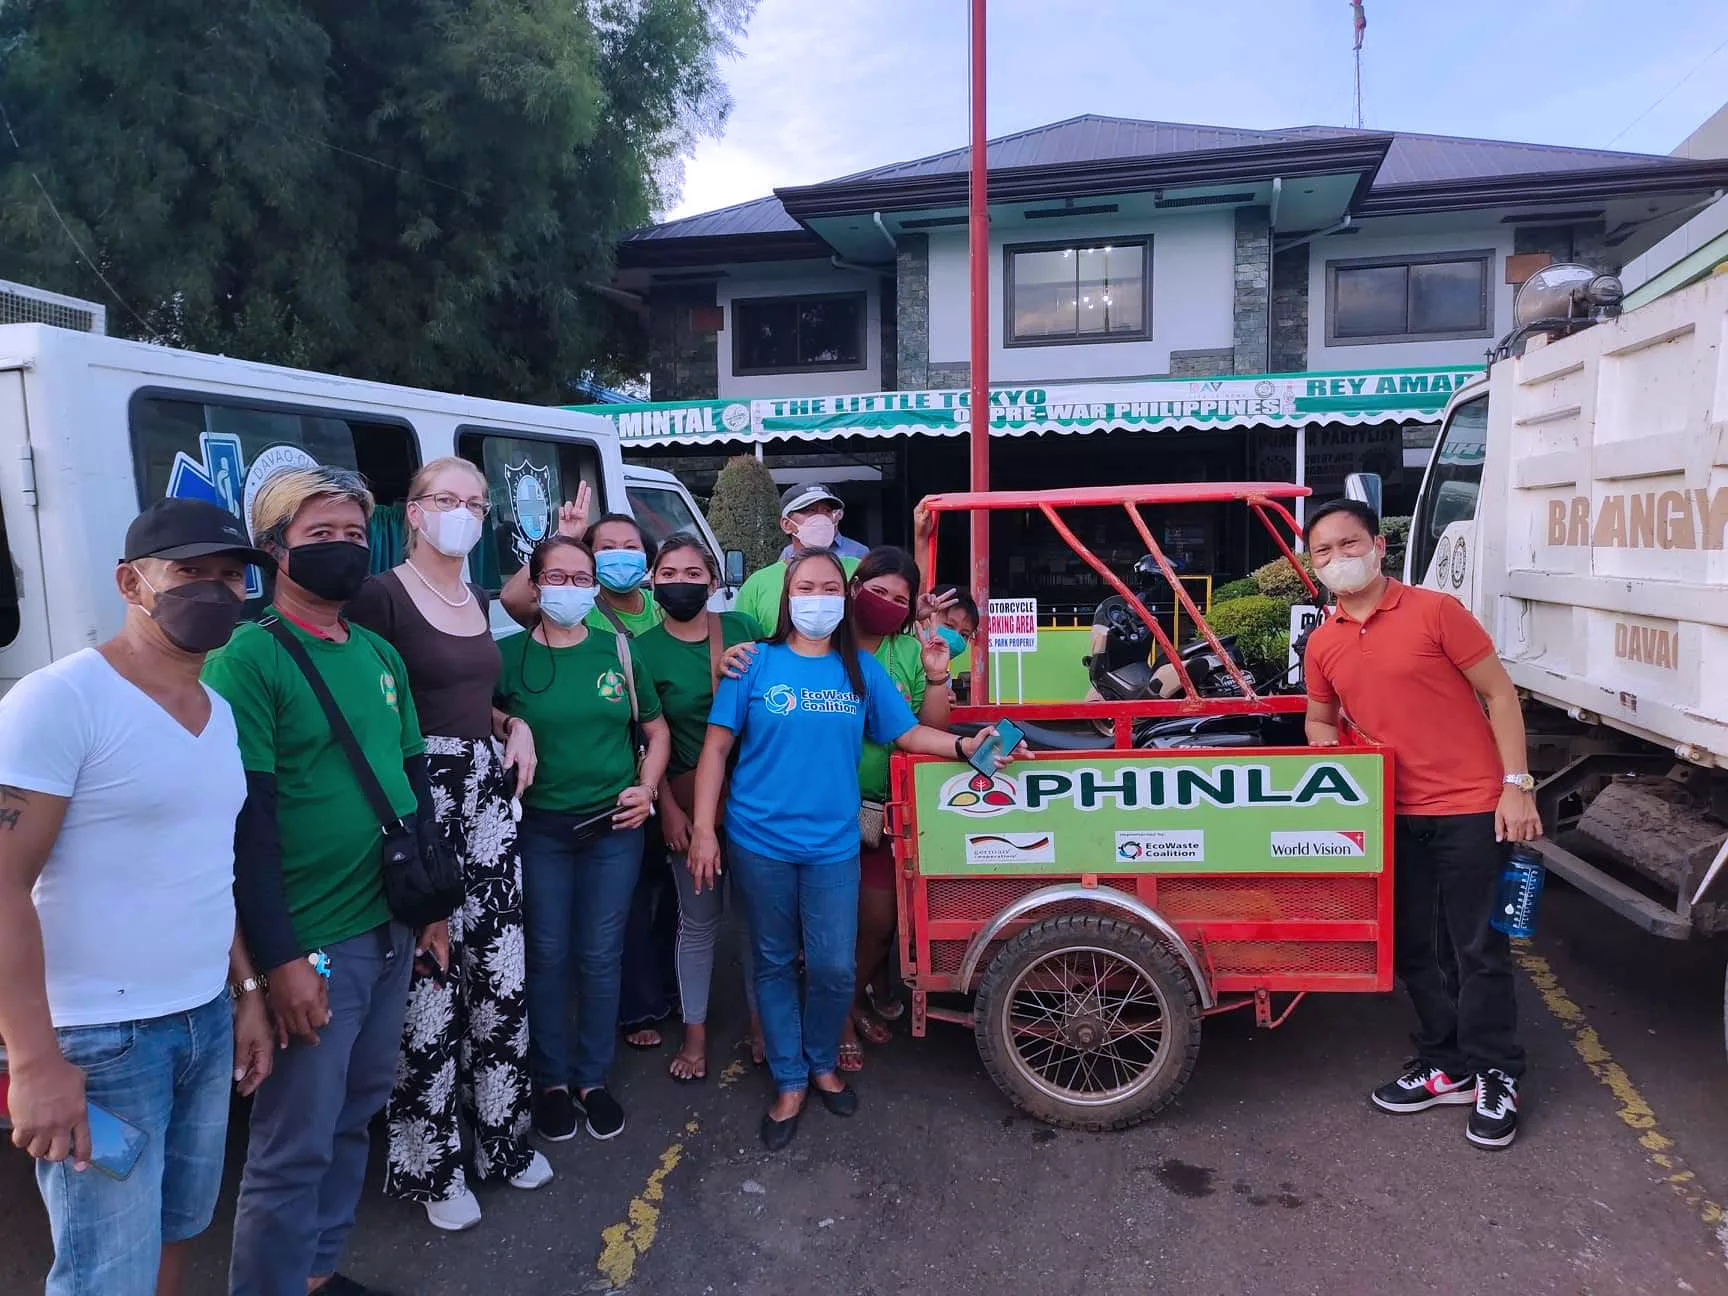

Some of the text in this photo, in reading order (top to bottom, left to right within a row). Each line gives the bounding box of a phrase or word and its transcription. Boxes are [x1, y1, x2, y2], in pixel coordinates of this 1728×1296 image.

[1306, 377, 1367, 396] REY
[769, 399, 827, 417] THE
[835, 393, 931, 412] LITTLE
[990, 403, 1107, 421] PRE-WAR
[1113, 399, 1281, 418] PHILIPPINES
[619, 407, 717, 437] MINTAL
[254, 449, 294, 480] DAVAO
[989, 601, 1033, 614] OTORCYCLE
[1015, 615, 1035, 634] AREA
[801, 688, 860, 704] EcoWaste
[801, 700, 857, 715] Coalition
[1026, 766, 1360, 808] PHINLA
[1145, 842, 1200, 850] EcoWaste
[1272, 842, 1351, 856] World Vision
